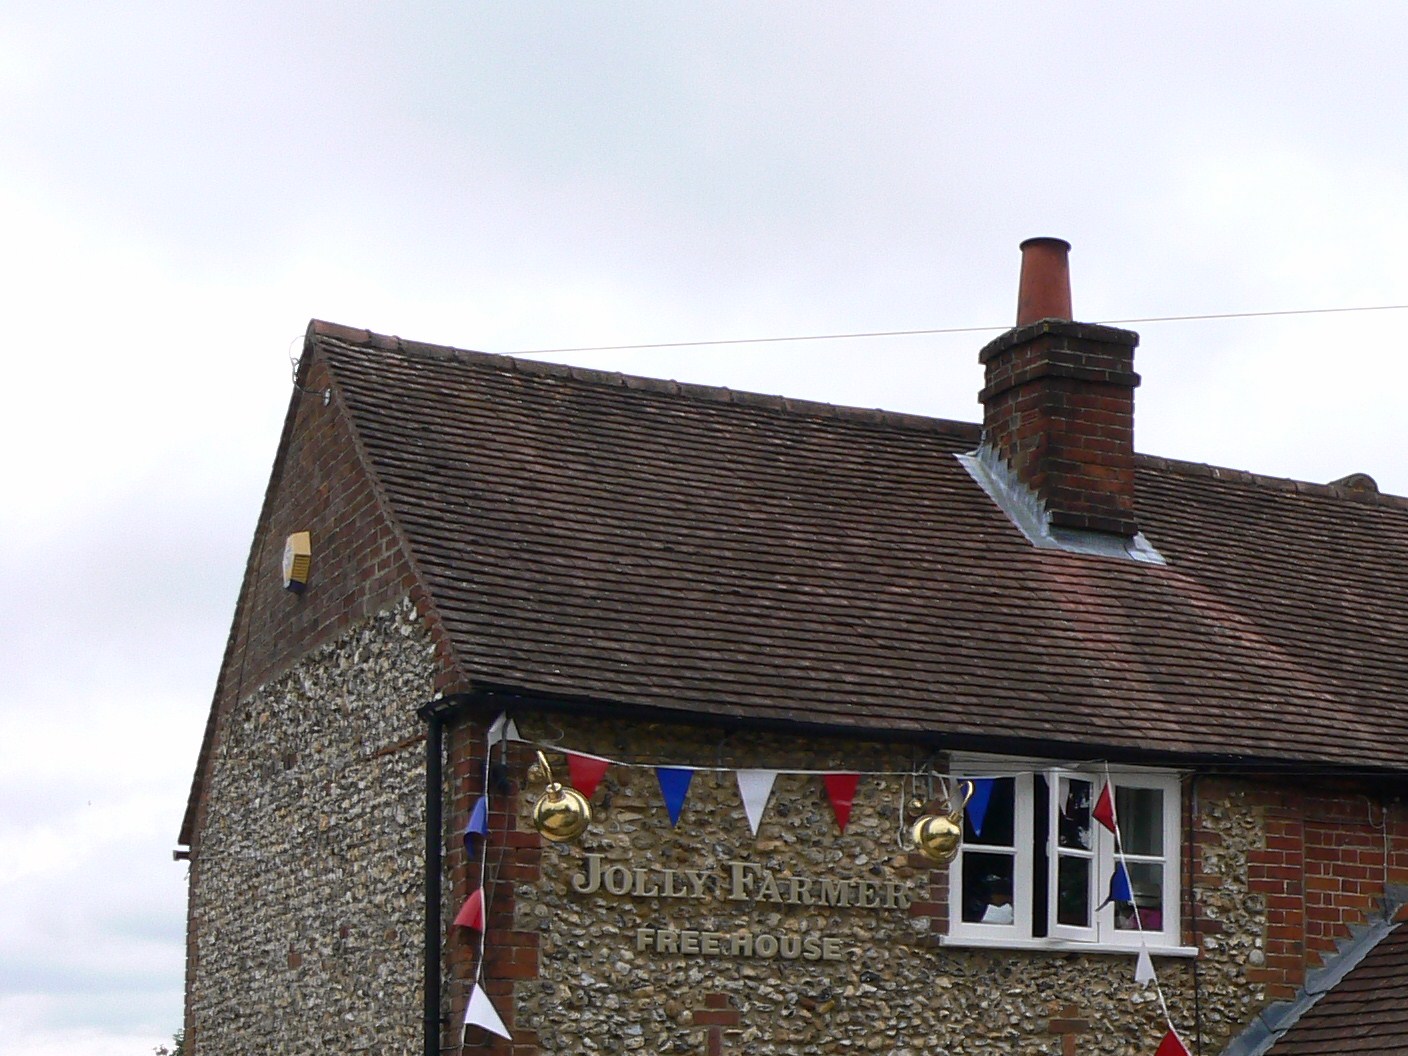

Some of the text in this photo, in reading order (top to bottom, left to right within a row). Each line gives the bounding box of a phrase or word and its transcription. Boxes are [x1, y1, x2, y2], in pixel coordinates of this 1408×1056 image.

[571, 853, 911, 910] JOLLY FARMER
[636, 928, 843, 961] FREE HOUSE
